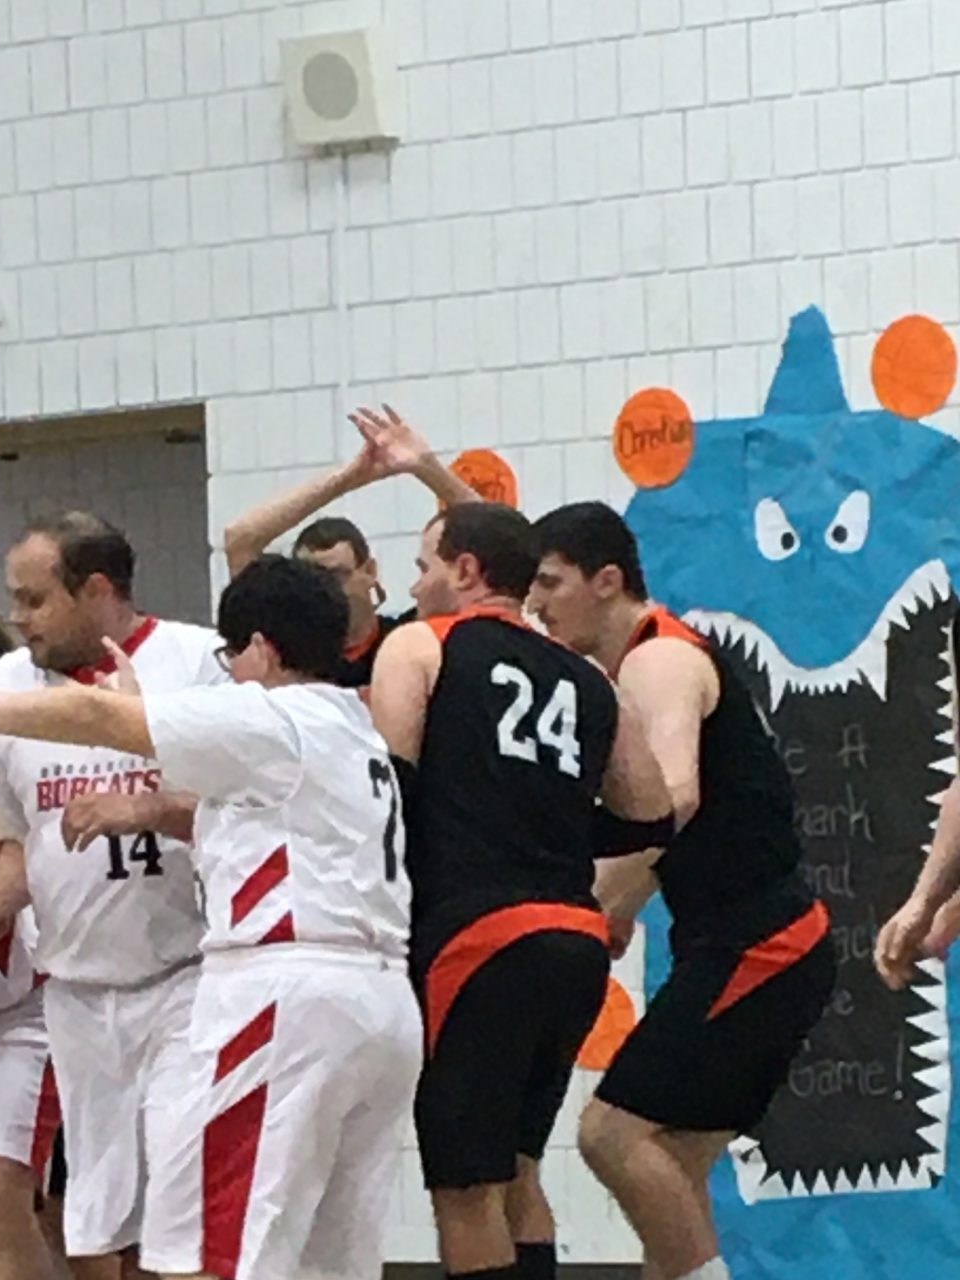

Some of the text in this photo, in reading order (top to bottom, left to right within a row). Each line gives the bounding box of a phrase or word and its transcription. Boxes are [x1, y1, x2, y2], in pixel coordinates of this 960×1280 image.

[491, 662, 581, 779] 24
[793, 783, 875, 843] hark
[105, 829, 164, 880] 14
